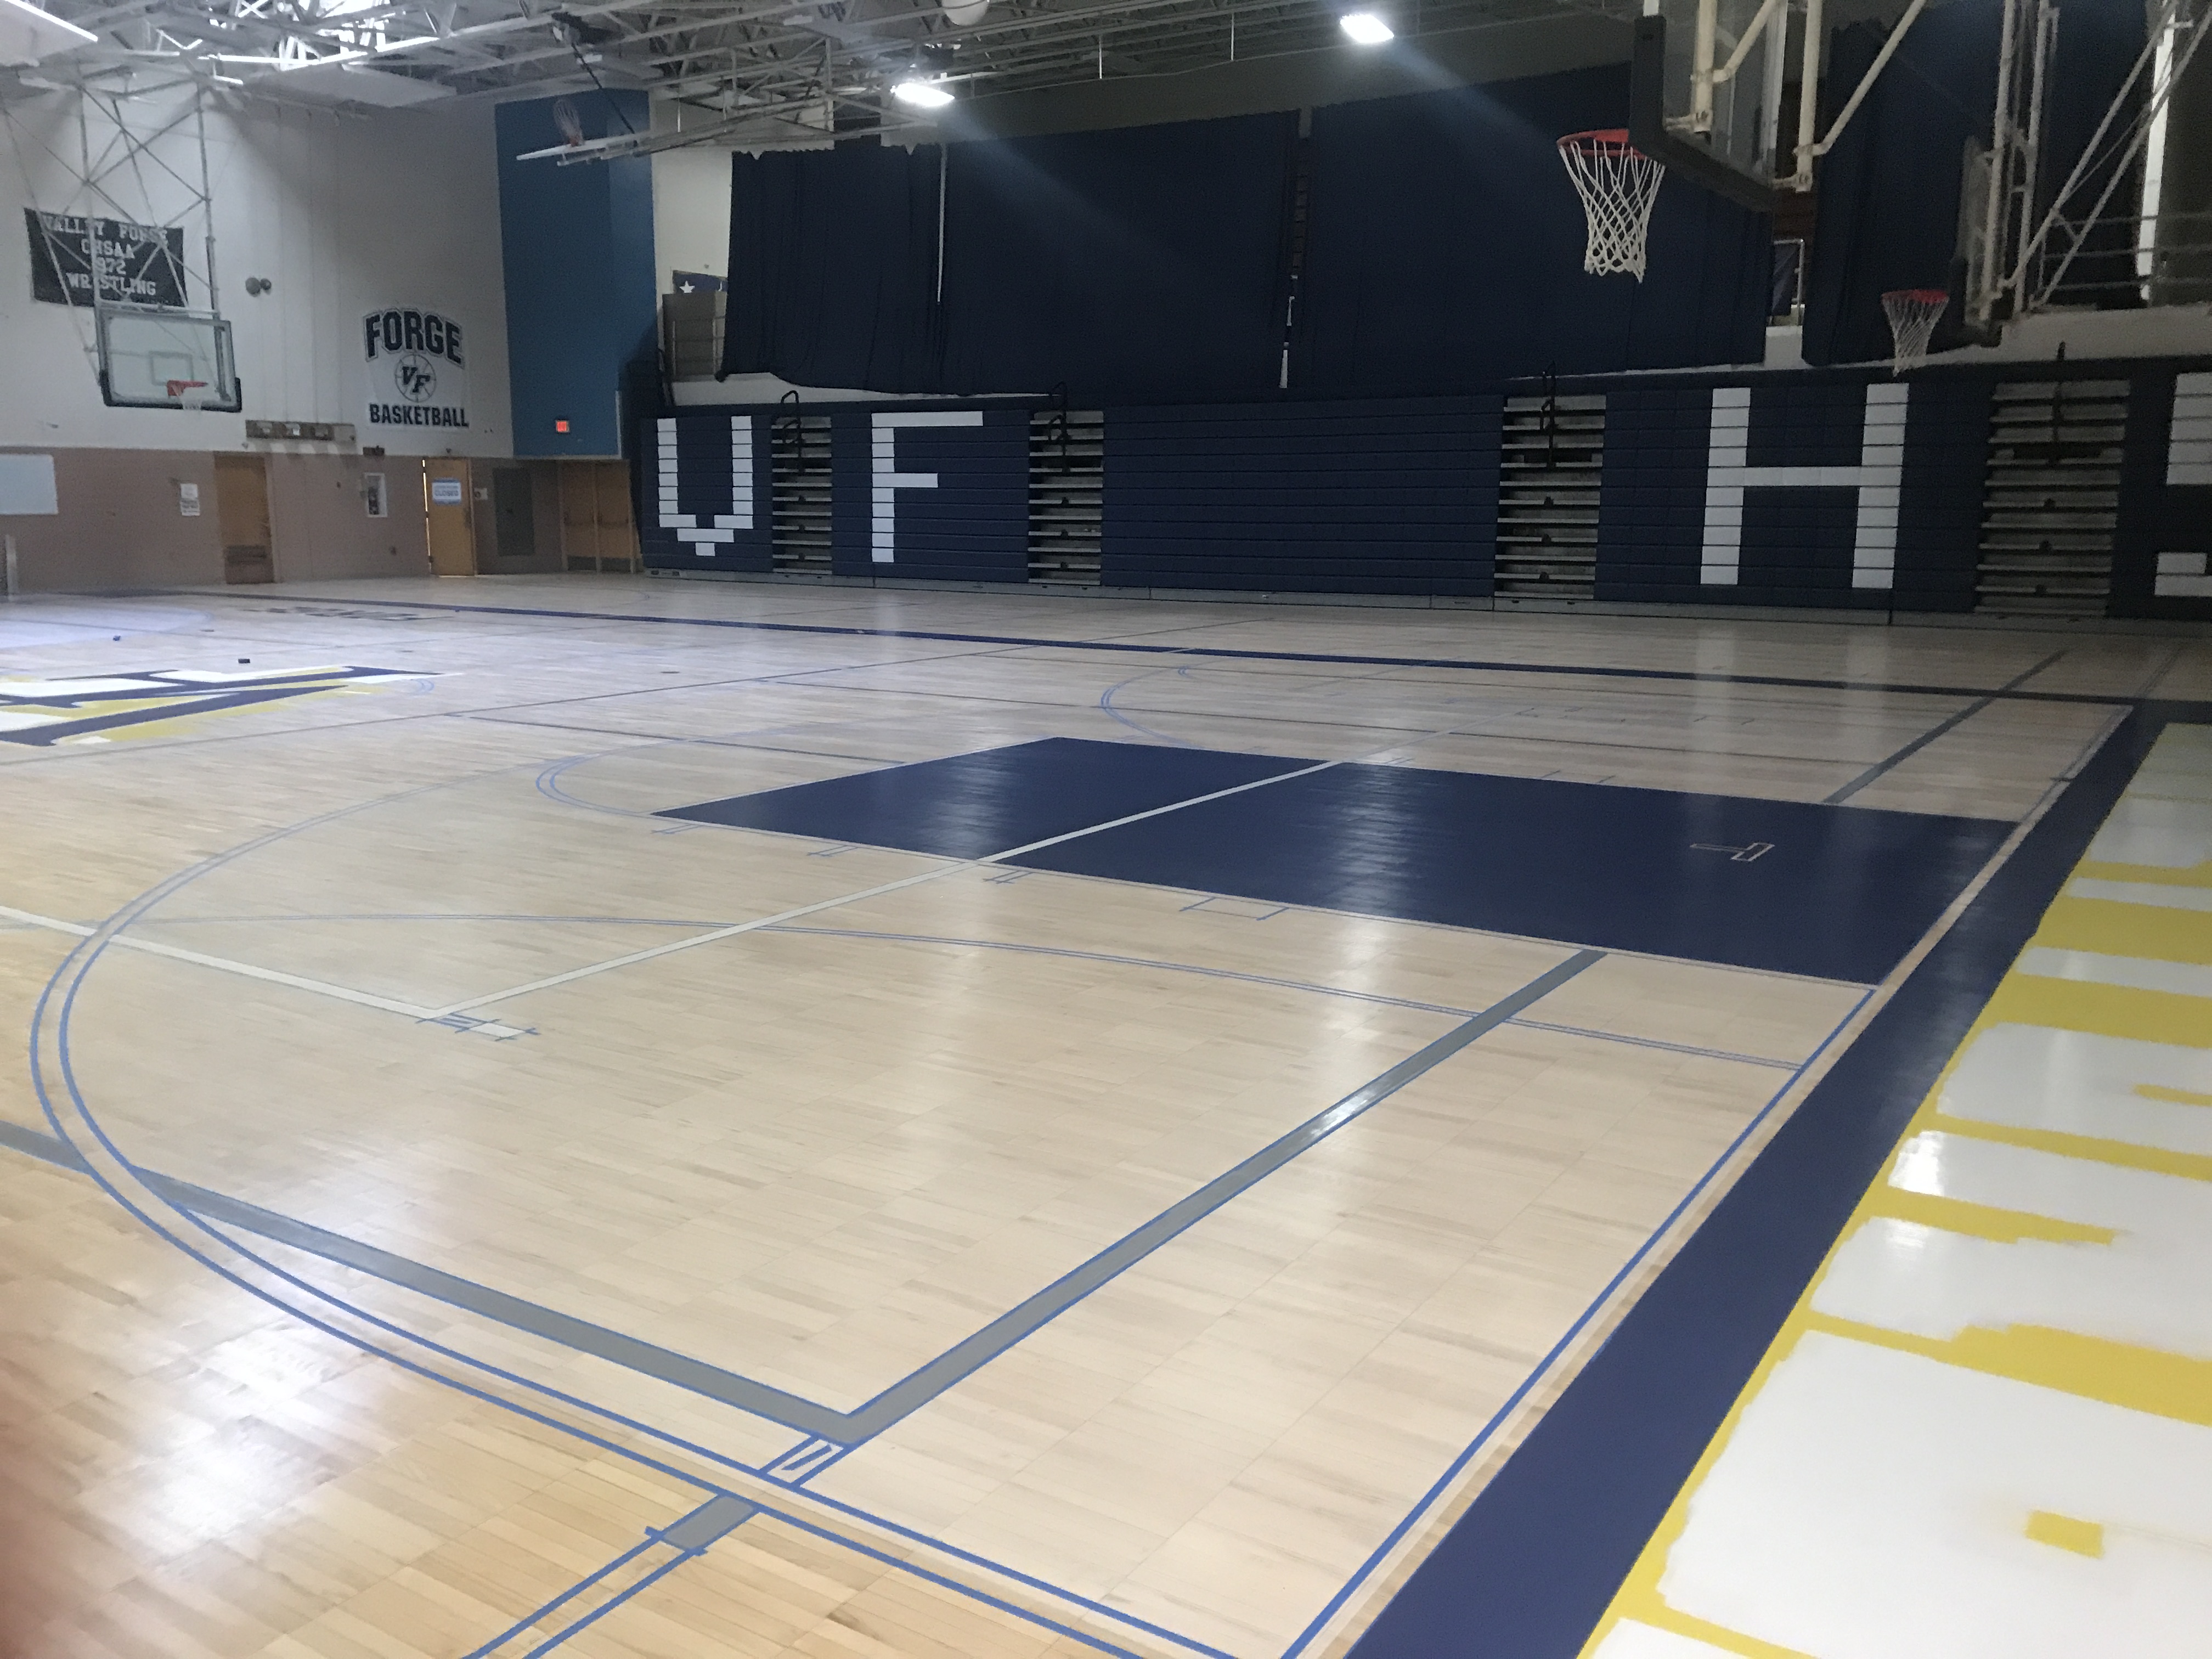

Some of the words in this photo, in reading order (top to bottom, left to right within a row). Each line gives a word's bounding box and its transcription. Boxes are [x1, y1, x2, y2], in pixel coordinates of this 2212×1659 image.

[42, 215, 105, 236] VALLY
[66, 272, 156, 296] WRSTLING
[364, 309, 463, 366] FORGE
[400, 365, 431, 394] VF
[369, 403, 470, 427] BASKETBALL
[871, 410, 984, 563] F
[1700, 382, 1910, 589] H
